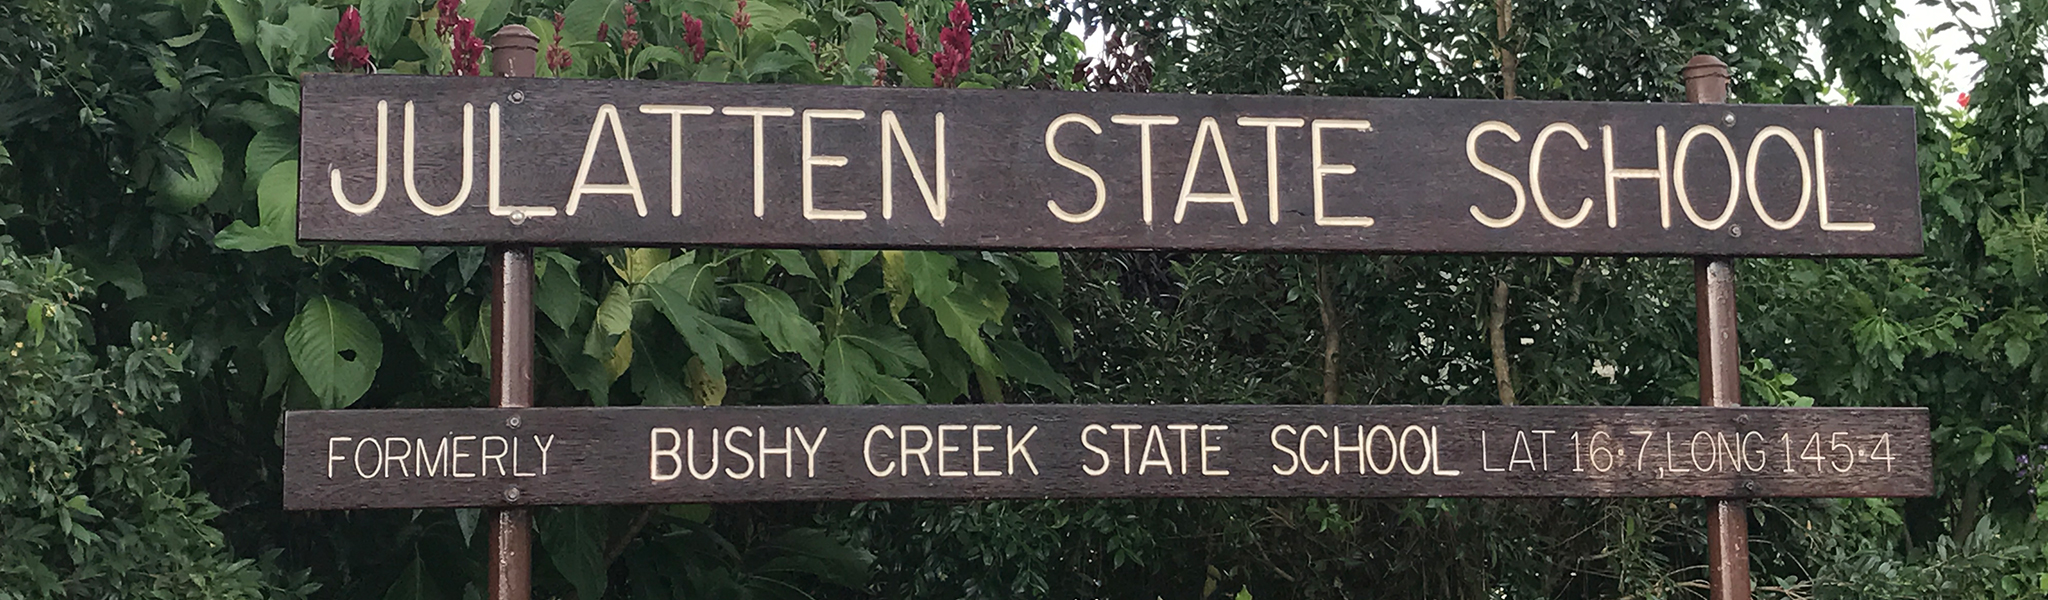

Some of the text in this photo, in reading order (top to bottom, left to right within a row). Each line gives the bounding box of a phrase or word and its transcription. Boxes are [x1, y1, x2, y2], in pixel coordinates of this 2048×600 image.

[330, 98, 1876, 233] JULATTEN STATE SCHOOL
[328, 433, 555, 479] FORMERLY
[650, 425, 828, 482] BUSHY
[863, 424, 1039, 477] CREEK
[1080, 423, 1230, 476] STATE
[1270, 424, 1461, 477] SCHOOL
[1481, 429, 1557, 472] LAT
